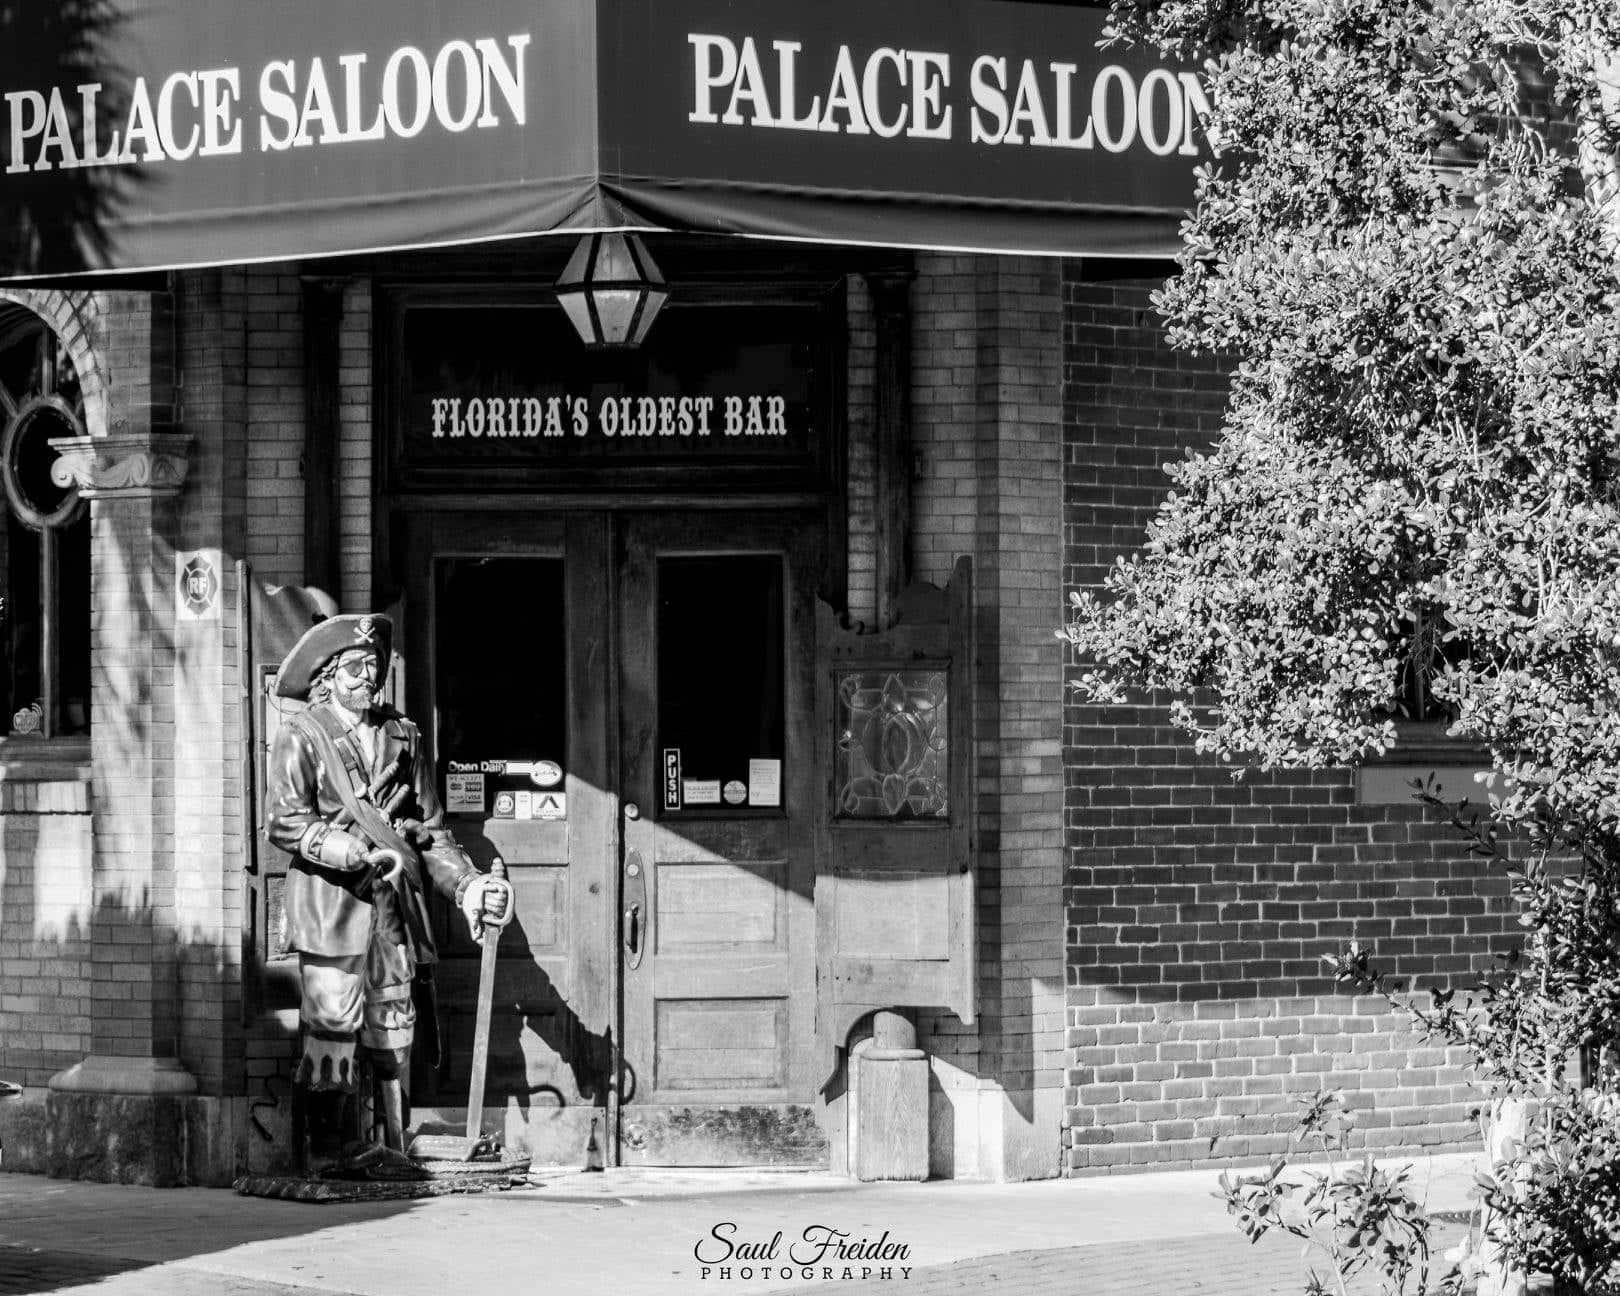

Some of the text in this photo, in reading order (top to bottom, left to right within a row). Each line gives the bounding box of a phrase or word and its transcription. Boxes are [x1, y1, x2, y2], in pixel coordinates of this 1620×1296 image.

[4, 34, 531, 173] PALACE SALOON
[688, 33, 952, 140] PALACE
[431, 394, 787, 438] FLORIDA'S OLDEST BAR
[189, 577, 207, 594] RF
[448, 760, 507, 776] Open Daily
[667, 754, 677, 804] PUSH
